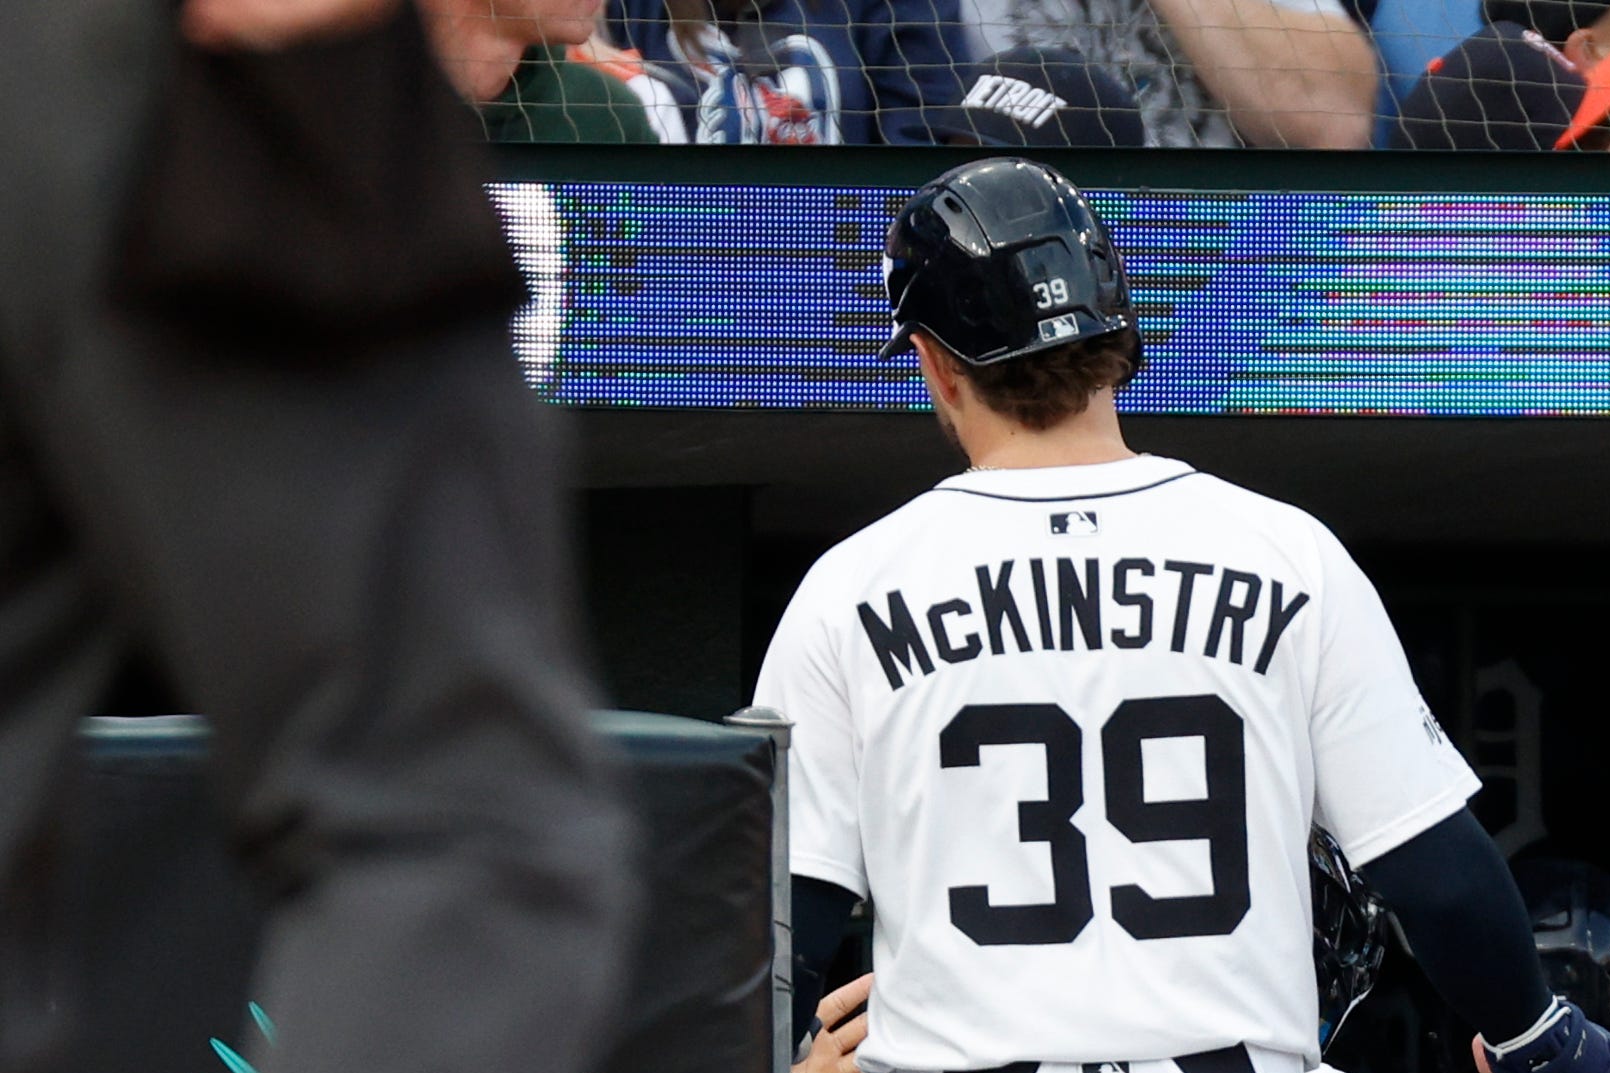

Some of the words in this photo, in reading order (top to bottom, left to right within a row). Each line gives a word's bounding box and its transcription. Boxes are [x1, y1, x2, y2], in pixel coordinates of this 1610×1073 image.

[1032, 277, 1069, 309] 39
[857, 557, 1310, 691] McKINSTRY
[938, 694, 1252, 947] 39
